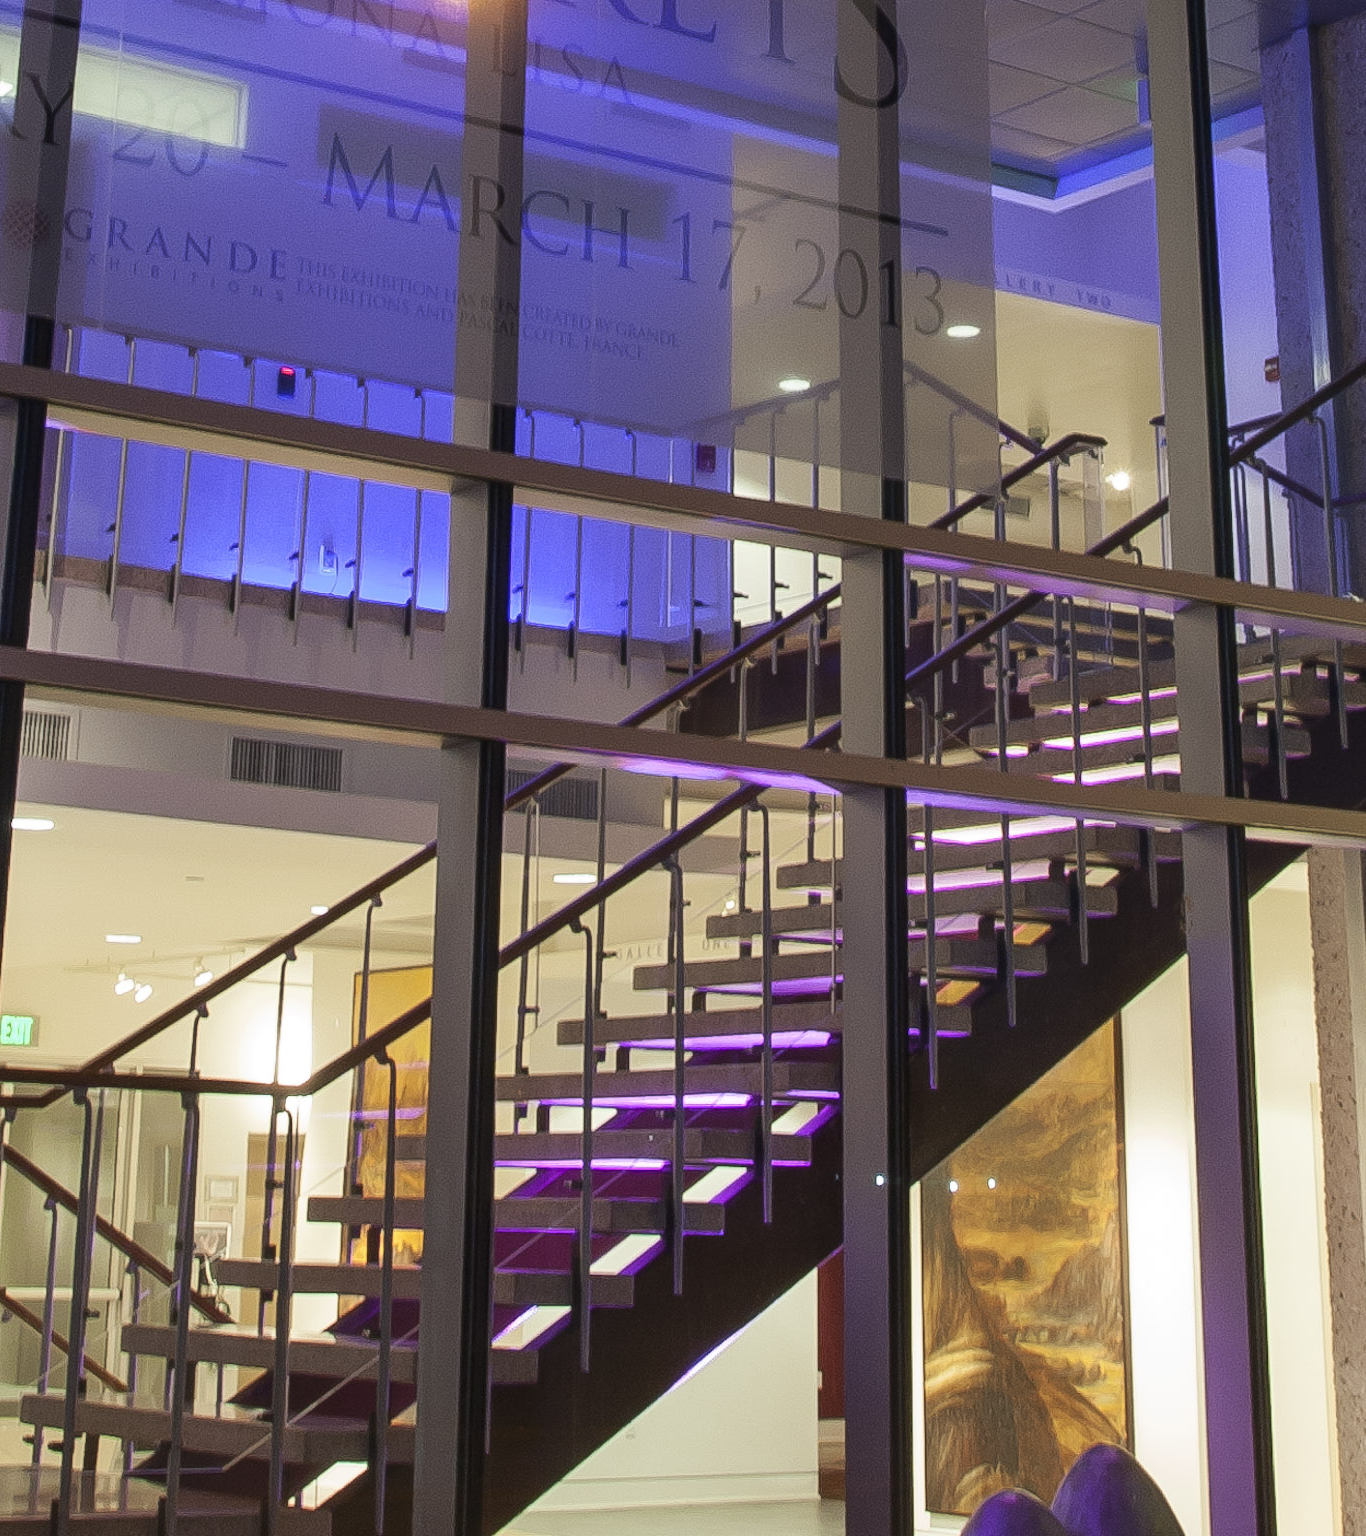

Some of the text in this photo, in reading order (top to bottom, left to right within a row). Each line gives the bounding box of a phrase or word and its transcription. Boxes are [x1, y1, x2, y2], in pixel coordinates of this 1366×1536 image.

[62, 206, 288, 283] GRANDE
[320, 130, 635, 271] MARCH
[790, 236, 946, 336] 2013
[1, 1015, 34, 1045] EXIT
